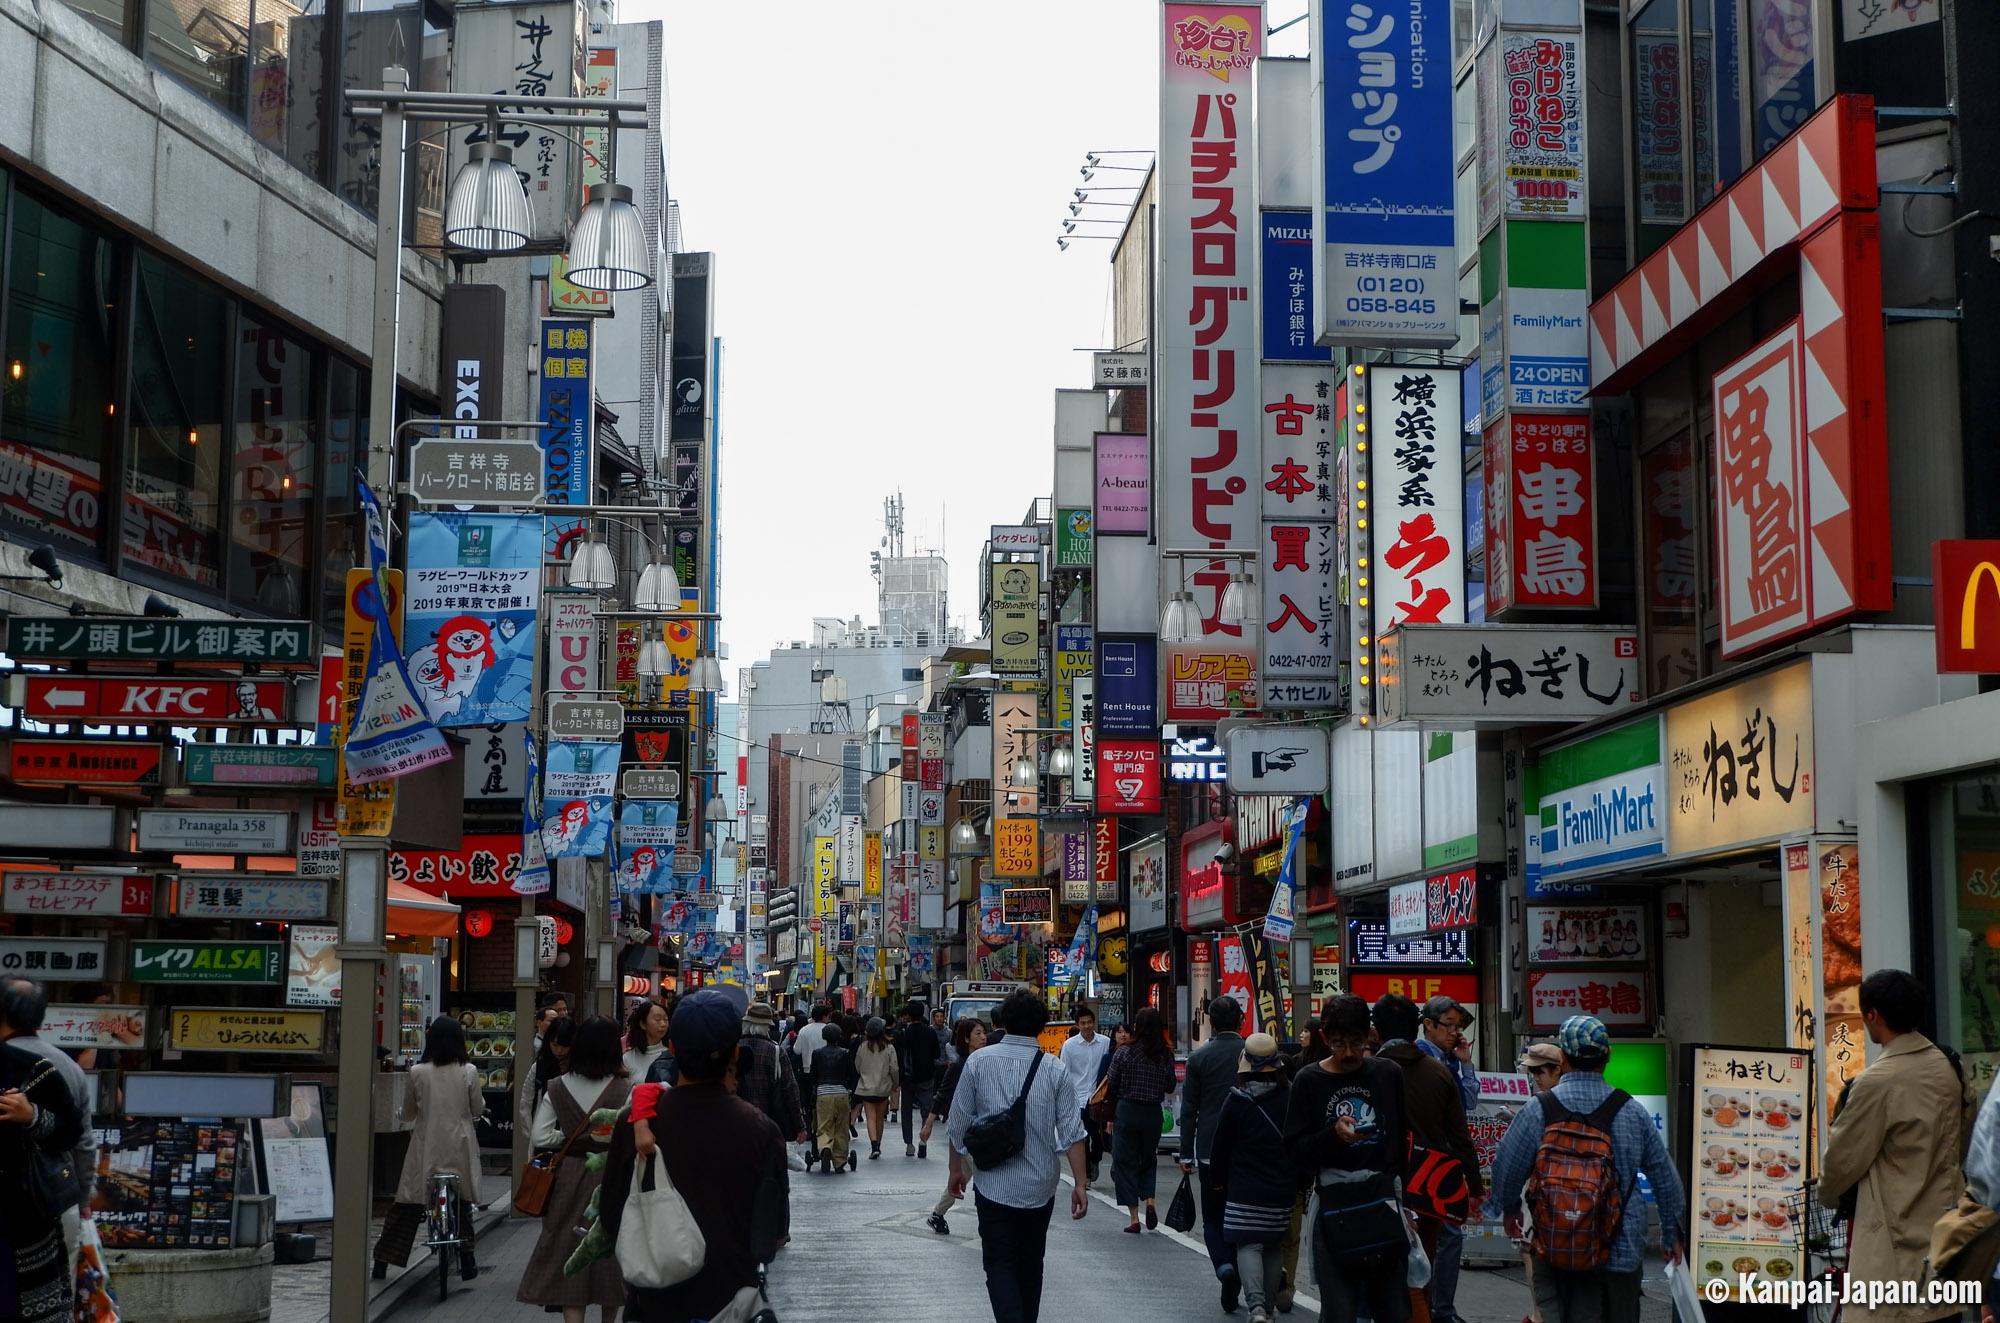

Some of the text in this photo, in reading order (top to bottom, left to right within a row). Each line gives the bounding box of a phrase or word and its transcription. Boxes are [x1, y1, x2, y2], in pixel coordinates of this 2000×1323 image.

[1410, 0, 1428, 88] nication
[1535, 39, 1566, 150] みけねこ
[1345, 253, 1436, 270] 吉祥寺南口店
[1357, 276, 1424, 294] (0120)
[573, 291, 608, 305] 入口
[1289, 267, 1305, 346] みずほ銀行
[1347, 298, 1435, 314] 058-845
[1514, 315, 1582, 329] FamilyMart
[547, 329, 588, 349] 日焼
[544, 358, 587, 378] 個室
[1104, 367, 1147, 379] 安藤商
[1516, 388, 1584, 405] 酒 たばこ
[675, 405, 701, 416] glitter
[1515, 424, 1586, 436] やきとり専門
[546, 388, 571, 506] BRONZE
[1392, 374, 1437, 508] 横浜家系
[1515, 438, 1586, 454] さっぽろ
[448, 453, 510, 469] 吉祥寺
[571, 418, 584, 493] salon tanning
[677, 454, 690, 465] club
[420, 472, 536, 491] パークロード商店会
[1518, 462, 1586, 595] 串鳥
[994, 535, 1038, 544] イケダビル
[418, 571, 529, 581] ラグビーワールドカップ
[1318, 525, 1332, 648] マンガ・ビデオ
[560, 605, 591, 615] コスプレ
[556, 618, 594, 629] キャバクラ
[23, 623, 300, 657] 井ノ頭ビル御案内
[1269, 655, 1332, 668] 0422-47-0727
[1412, 655, 1447, 666] 牛たん
[1431, 670, 1459, 681] とろろ
[1464, 644, 1625, 706] ねぎし
[1174, 682, 1226, 708] 聖地
[1269, 686, 1332, 701] 大竹ビル
[1422, 685, 1452, 696] 麦めし
[120, 686, 208, 713] KFC
[1103, 703, 1151, 711] Rent House
[570, 708, 606, 717] 吉祥寺
[651, 716, 686, 724] STOUTS
[555, 719, 619, 730] パークロード商店会
[68, 752, 139, 770] AMBIENCE
[210, 749, 328, 765] 吉祥寺情報センター
[1103, 751, 1154, 761] 電子タバコ
[1113, 763, 1144, 772] 専門店
[1703, 707, 1799, 823] ねぎし
[1563, 782, 1654, 848] FamilyMart
[179, 819, 266, 834] Pranagala 358
[216, 840, 239, 848] studio
[1000, 849, 1031, 858] 生ビール
[867, 840, 877, 889] FOREST
[13, 877, 113, 892] まつ毛エクステ
[1826, 855, 1849, 914] 牛たん
[124, 886, 152, 906] 3F
[199, 888, 244, 907] 理髪
[135, 948, 262, 970] レイクALSA
[268, 952, 279, 977] 2F
[1578, 981, 1642, 1014] 串鳥
[181, 1015, 190, 1042] 2F
[1832, 1023, 1854, 1087] 麦めし
[1725, 1058, 1785, 1083] ねぎし
